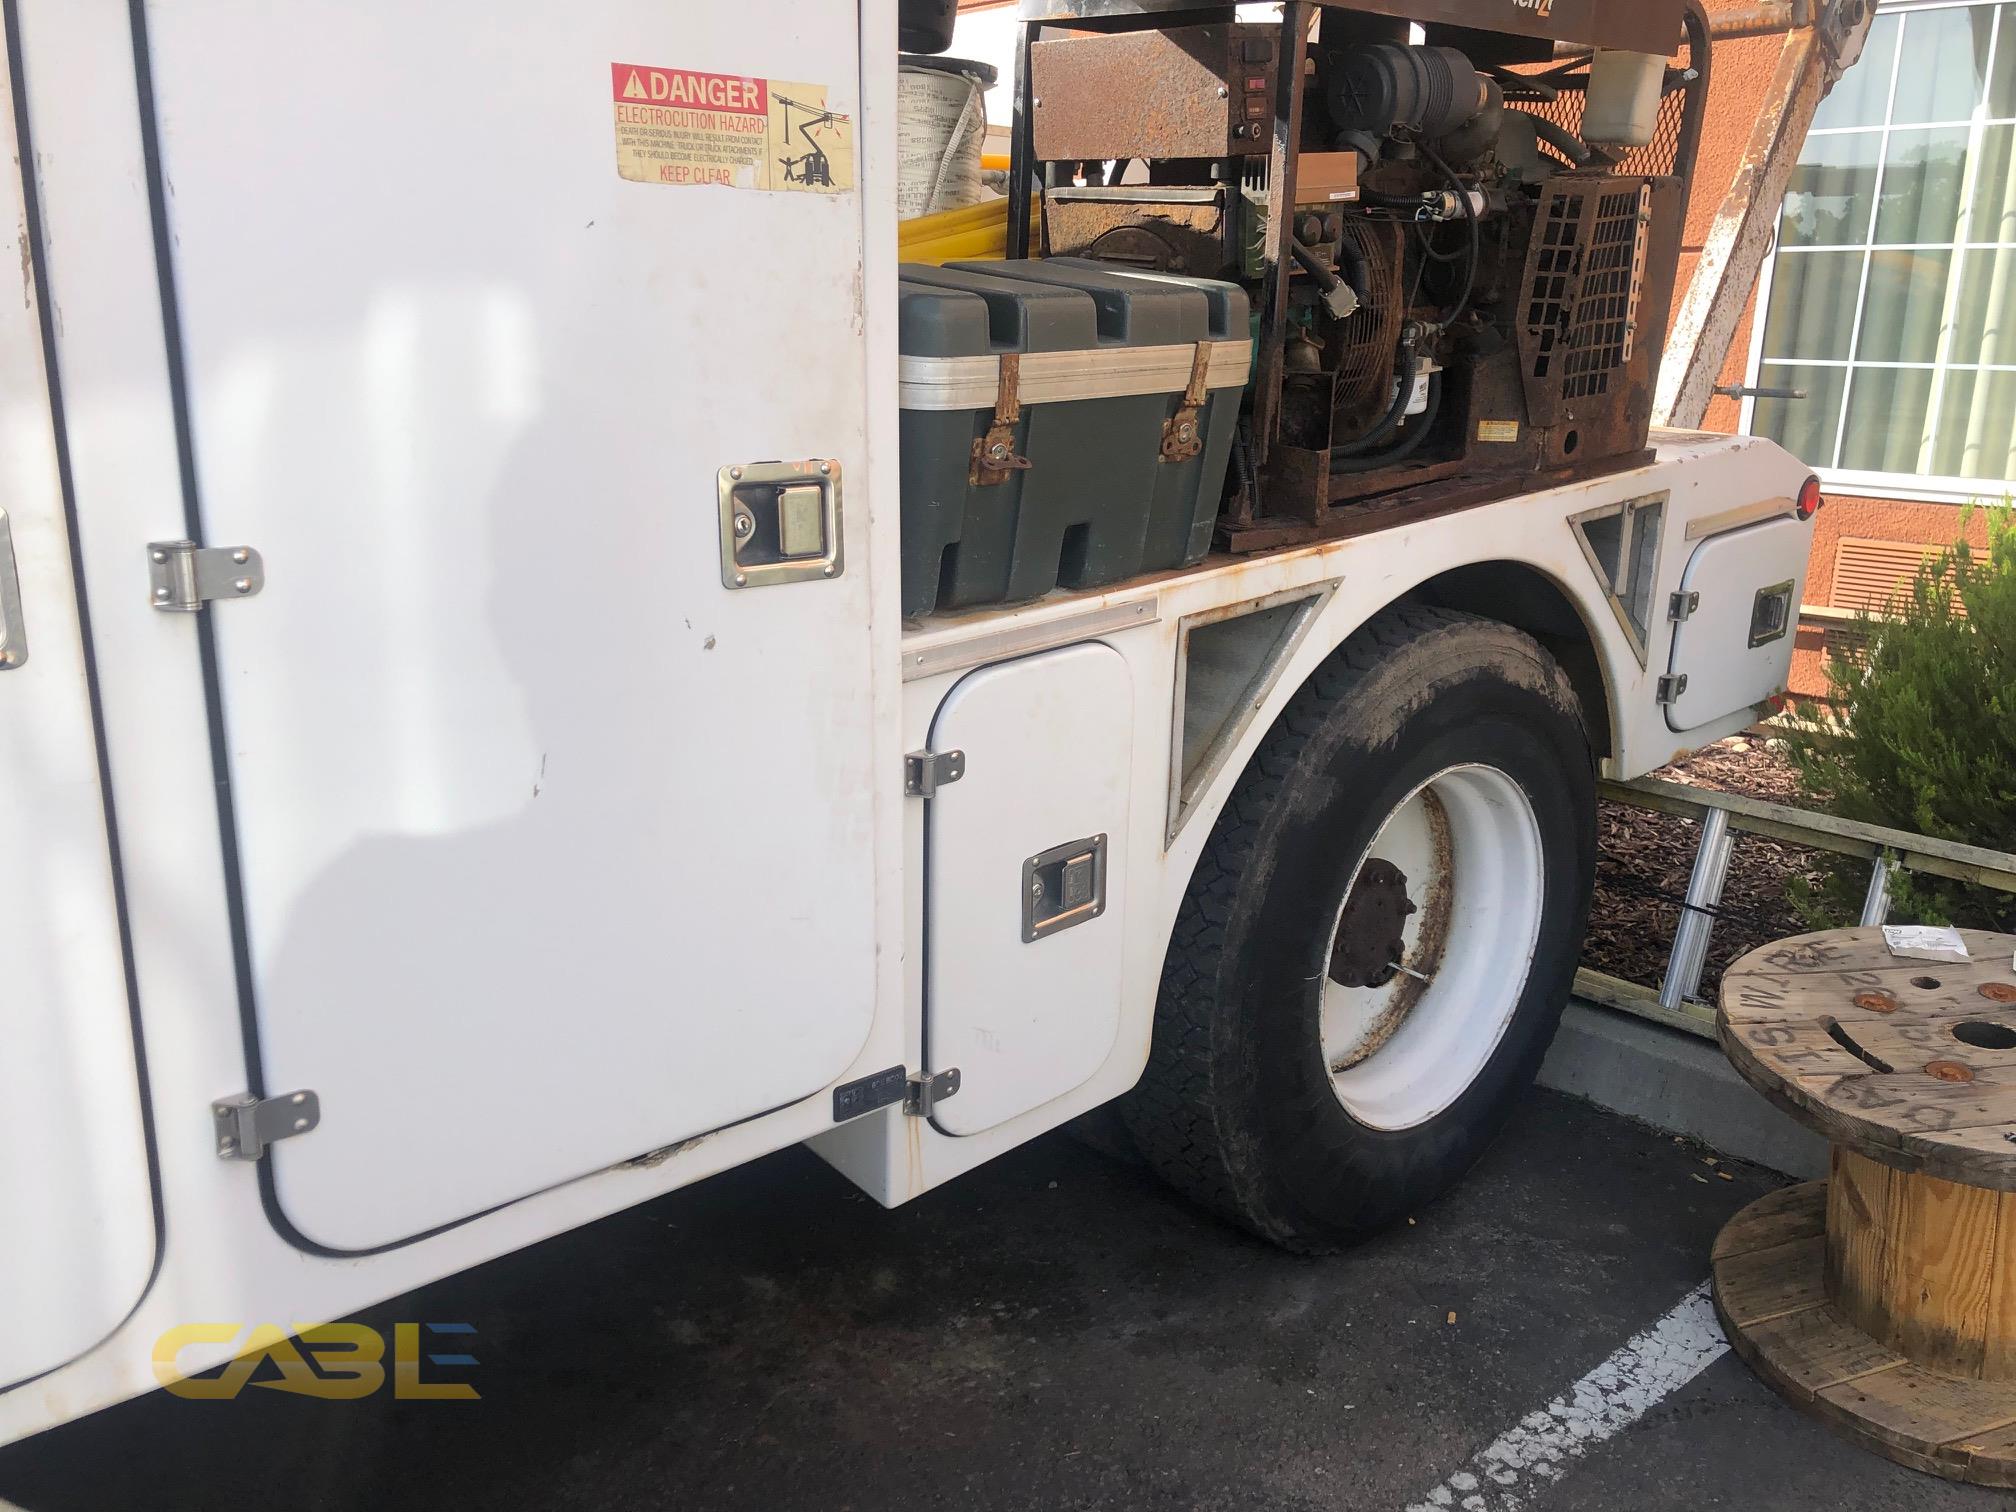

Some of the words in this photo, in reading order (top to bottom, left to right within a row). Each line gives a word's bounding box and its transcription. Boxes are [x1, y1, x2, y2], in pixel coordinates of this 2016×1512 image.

[650, 71, 759, 109] DANGER
[618, 106, 715, 130] ELECTROCUTION
[721, 115, 764, 134] HAZARD
[621, 126, 638, 135] DEATH
[640, 127, 649, 135] OR
[649, 128, 672, 138] SERIOUS
[674, 131, 691, 140] INJURY
[706, 133, 724, 142] RESULT
[726, 135, 740, 143] FROM
[741, 136, 762, 145] CONTACT
[622, 137, 635, 146] WITH
[637, 138, 649, 146] THIS
[678, 142, 694, 150] TRUCK
[696, 143, 704, 151] OR
[705, 144, 721, 153] TRUCK
[723, 145, 756, 155] ATTACHMENTS
[633, 149, 646, 158] THEY
[648, 150, 669, 159] SHOULD
[670, 152, 692, 161] BECOME
[694, 153, 728, 164] ELECTRICALLY
[660, 165, 689, 182] KEEP
[694, 167, 730, 185] CLEAR
